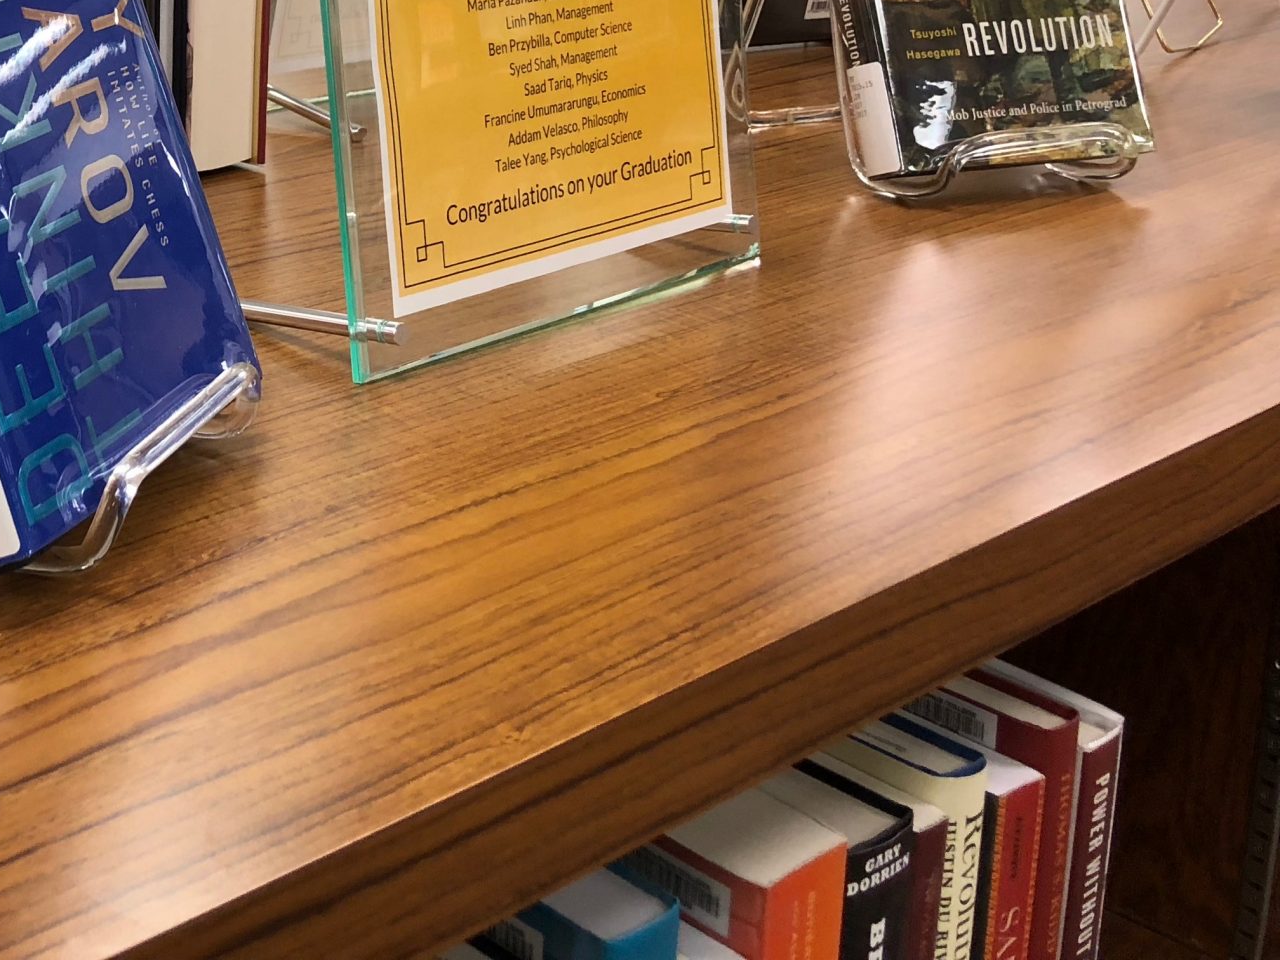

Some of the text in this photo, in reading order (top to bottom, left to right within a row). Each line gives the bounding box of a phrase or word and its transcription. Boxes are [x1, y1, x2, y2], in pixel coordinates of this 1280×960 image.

[487, 21, 633, 57] Ben Przybilla, Computer Science
[906, 47, 961, 61] Hasegawa
[910, 26, 957, 40] Tsuyoshi
[962, 14, 1114, 57] REVOLUTION
[523, 68, 609, 97] Saad Tariq, Physics
[120, 66, 157, 167] HOW LIFE
[484, 108, 527, 129] Francine
[600, 83, 647, 104] Economics
[972, 106, 1006, 121] Justice
[1009, 104, 1027, 116] and
[1030, 102, 1060, 115] Police
[1062, 101, 1073, 112] in
[1075, 96, 1127, 113] Petrograd
[507, 108, 629, 148] Addam Velasco, Philosophy
[108, 70, 169, 247] IMITATES CHESS
[494, 129, 643, 173] Talee Yang, Psychological Science
[446, 149, 693, 226] Congratulations on your Graduation
[847, 852, 910, 897] DORRIEN
[865, 843, 902, 873] GARY
[1076, 773, 1111, 956] POWER WITHOUT
